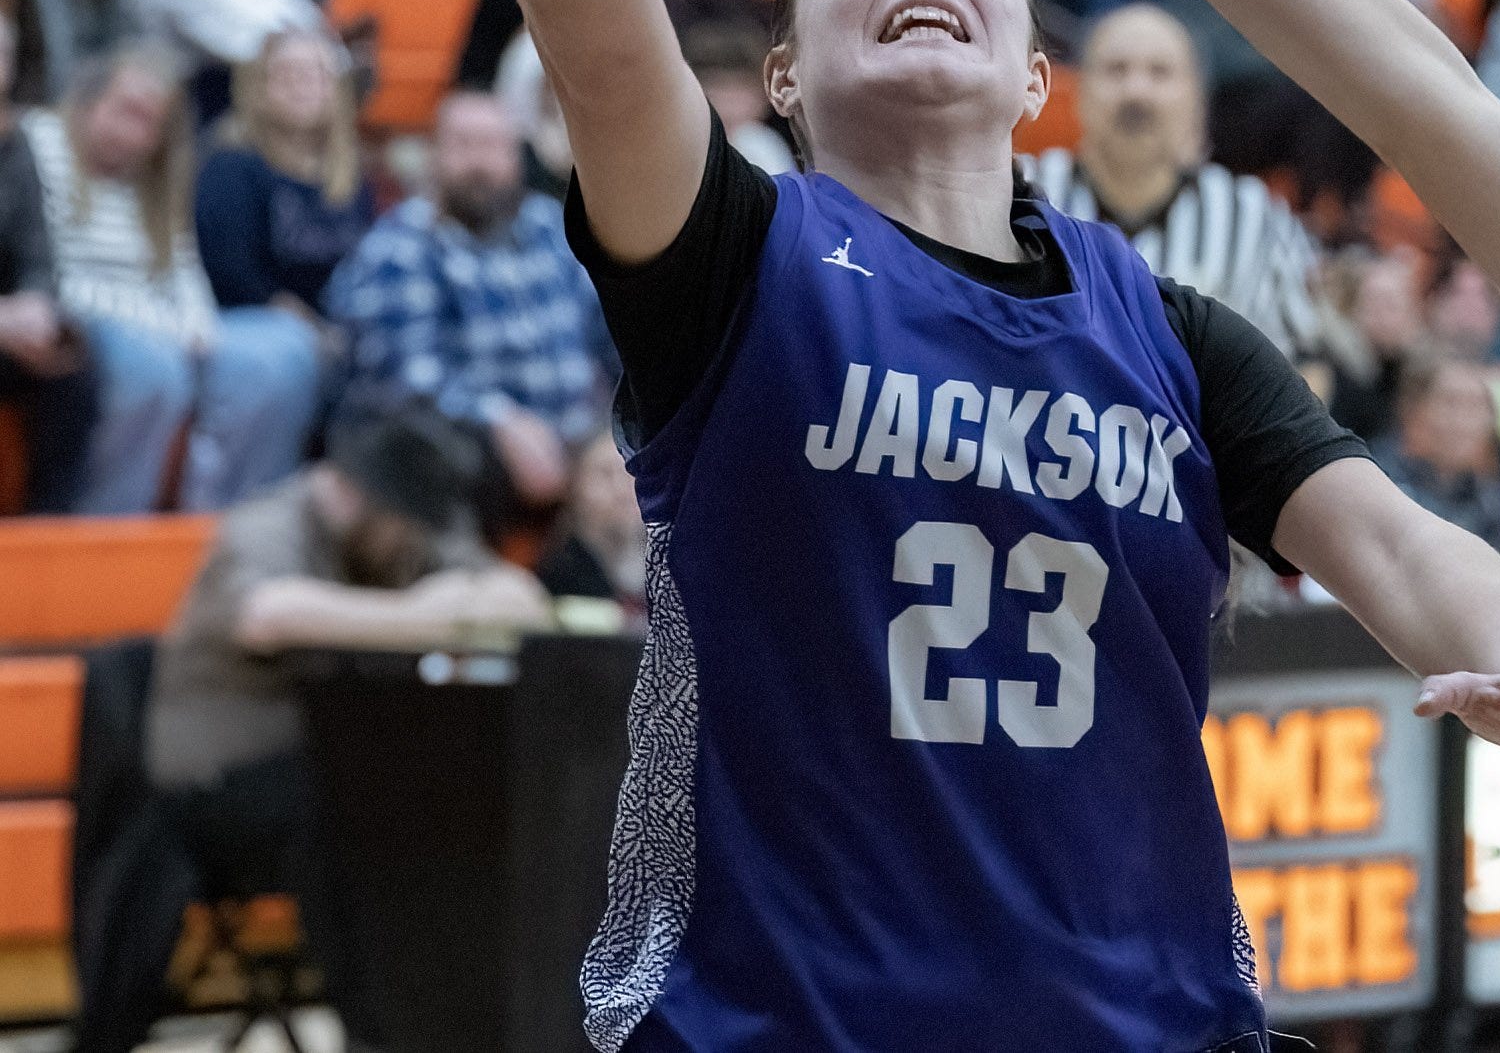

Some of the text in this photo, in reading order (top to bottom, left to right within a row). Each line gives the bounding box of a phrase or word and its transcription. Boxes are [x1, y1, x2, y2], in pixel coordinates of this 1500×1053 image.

[805, 362, 1192, 524] JACKSON
[888, 521, 1110, 749] 23
[1201, 704, 1384, 843] ME
